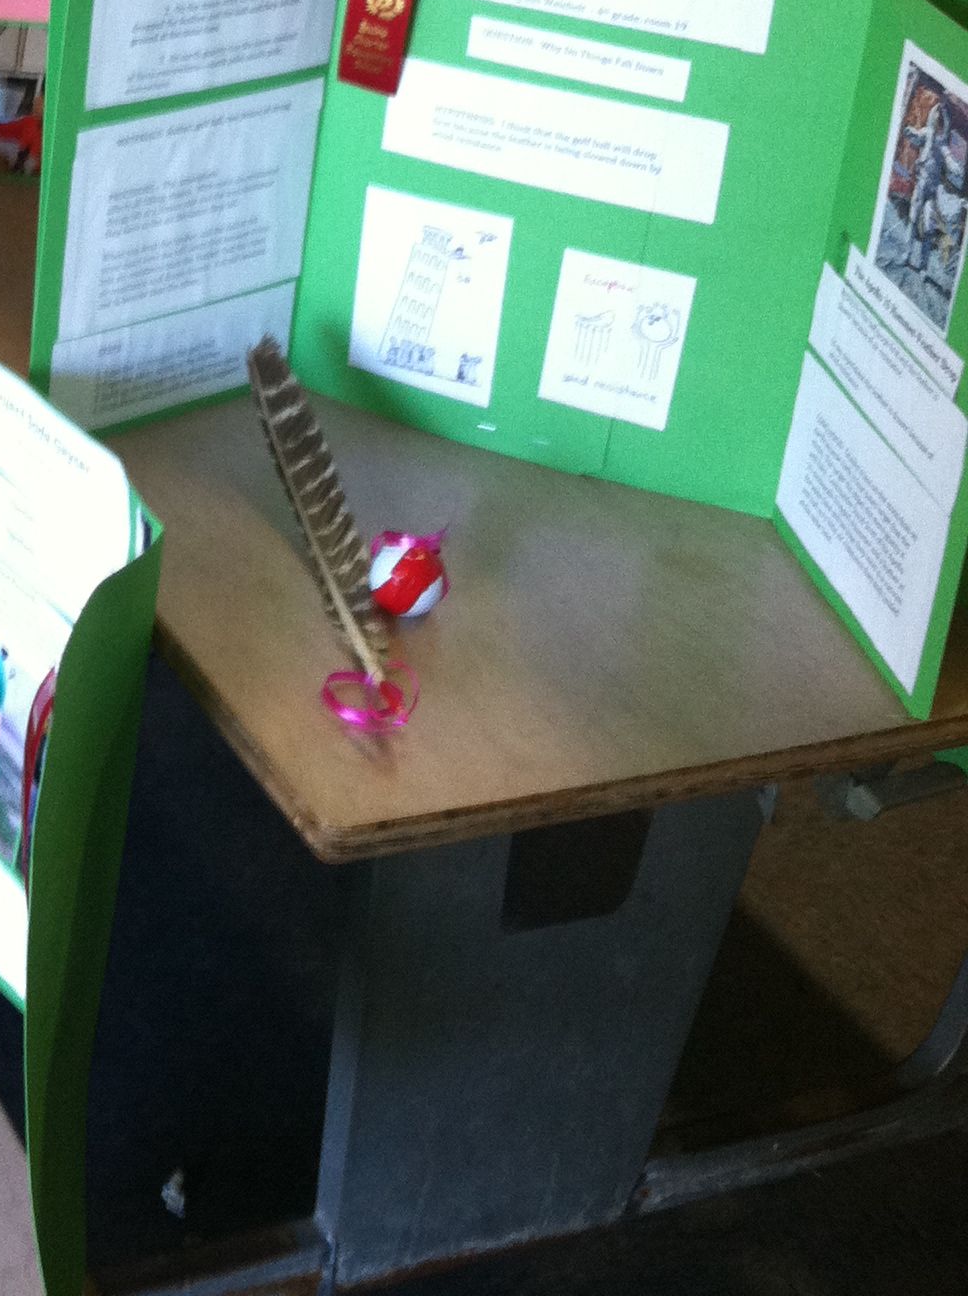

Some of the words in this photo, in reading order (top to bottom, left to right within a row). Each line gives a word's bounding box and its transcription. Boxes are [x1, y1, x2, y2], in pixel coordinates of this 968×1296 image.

[540, 40, 562, 55] Why
[580, 49, 612, 66] Things
[533, 124, 553, 139] that
[571, 132, 593, 148] golf
[632, 145, 658, 162] drop
[619, 154, 648, 171] down
[648, 160, 663, 177] by
[592, 376, 658, 403] resistance
